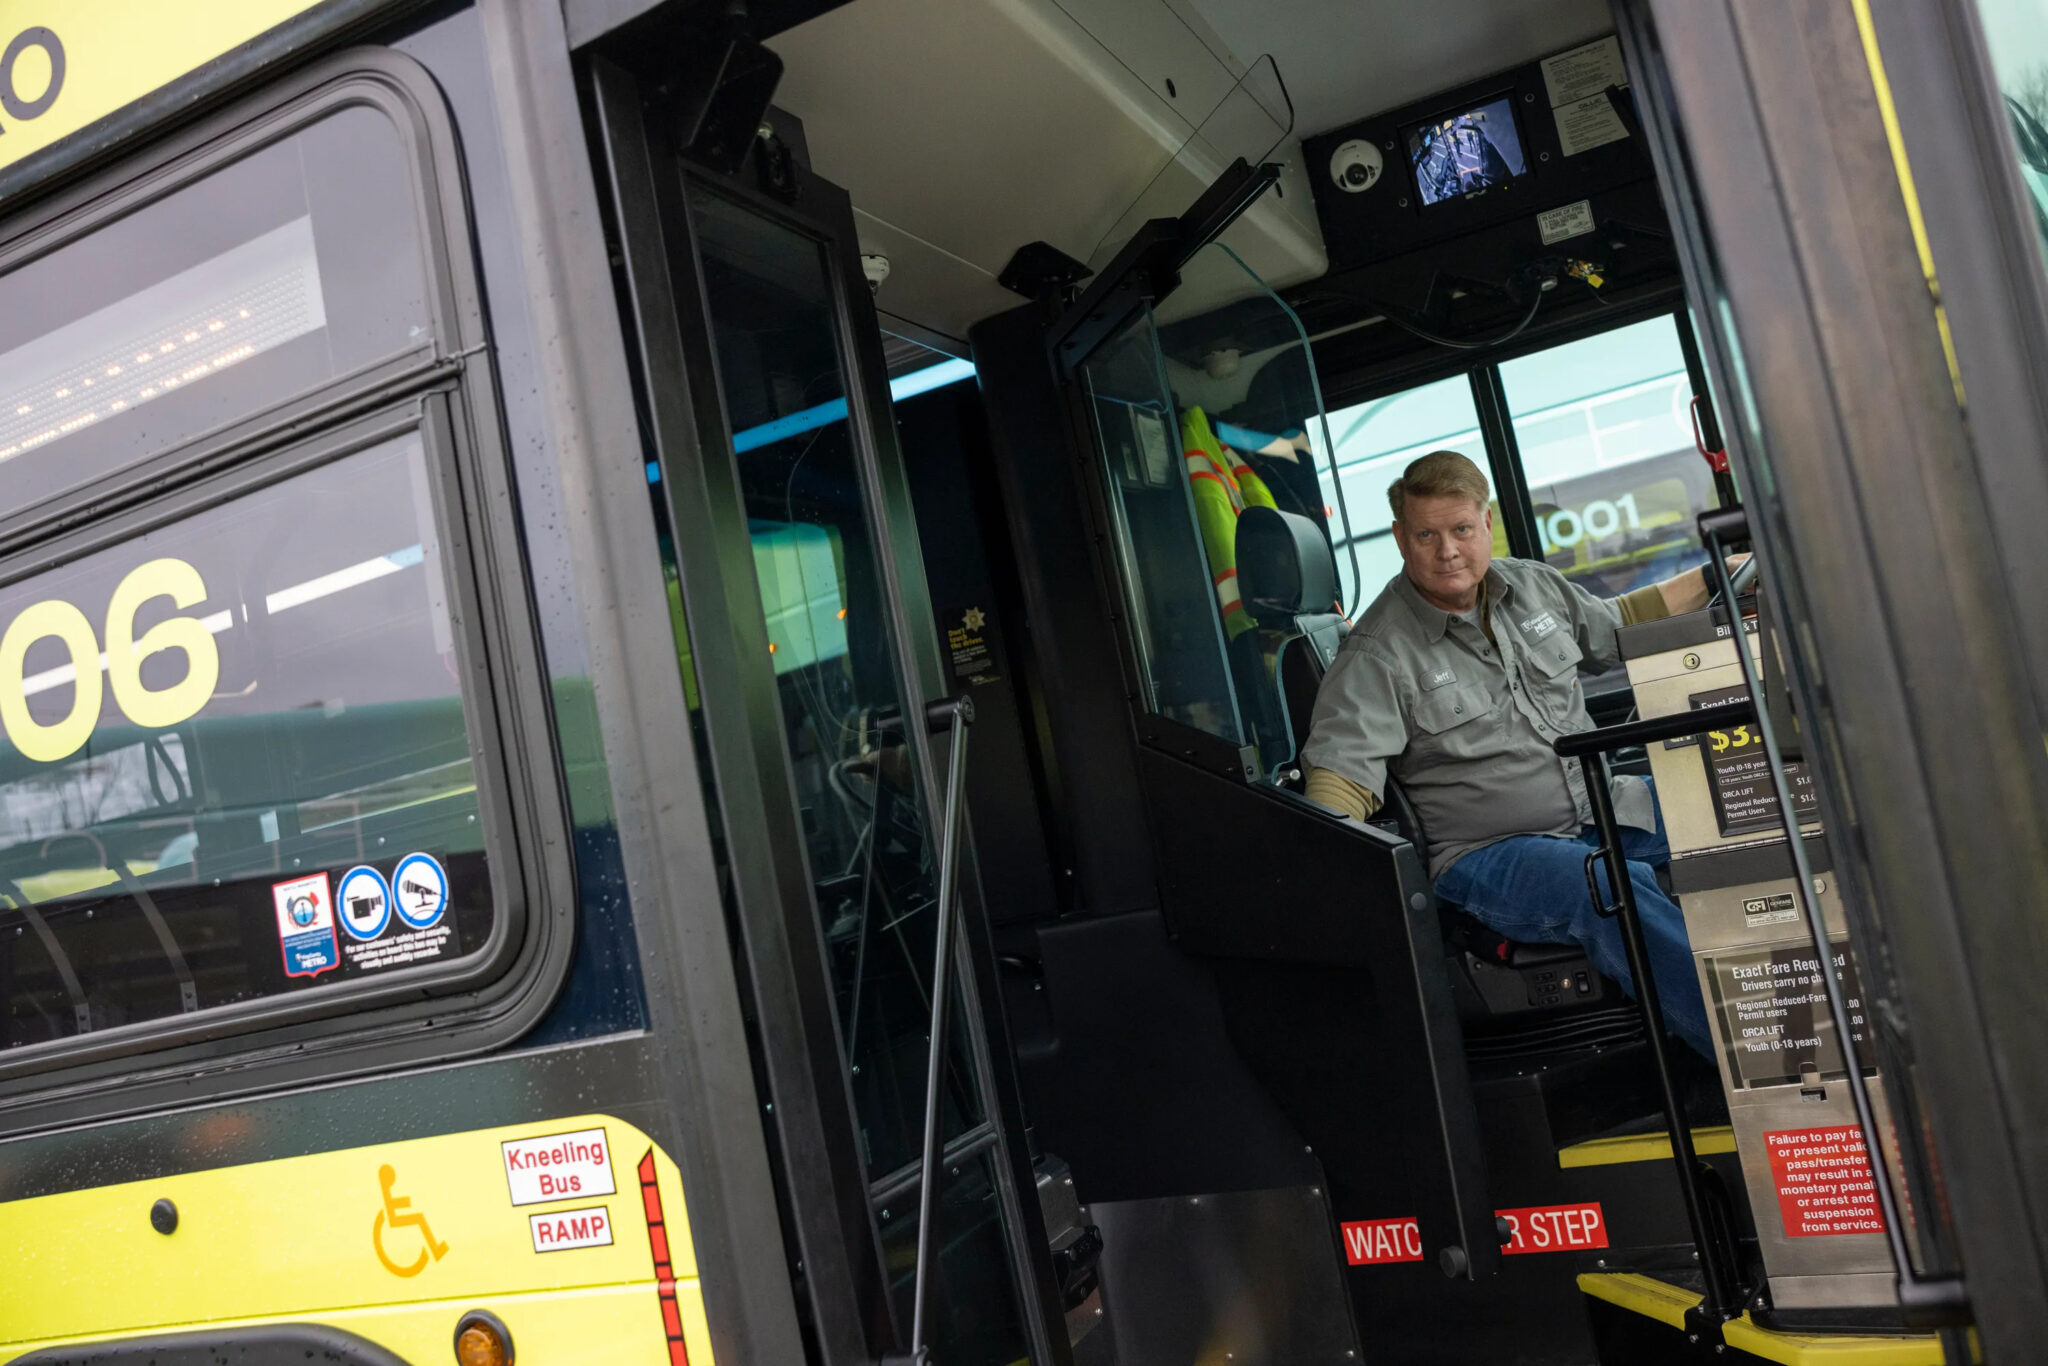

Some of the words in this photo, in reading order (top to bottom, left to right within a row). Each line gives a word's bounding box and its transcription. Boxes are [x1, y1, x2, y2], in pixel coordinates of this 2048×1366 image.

[1717, 626, 1731, 637] Bil
[0, 558, 219, 762] 06
[1434, 671, 1450, 684] Jeff
[1708, 725, 1762, 754] $3.
[1717, 764, 1735, 774] Youth
[1736, 762, 1752, 773] (0-18
[1753, 760, 1768, 771] year
[1722, 788, 1740, 799] ORCA
[1741, 786, 1754, 796] LIFT
[1725, 800, 1752, 811] Regional
[1727, 809, 1747, 819] Permit
[1748, 806, 1766, 816] Users
[1732, 964, 1762, 980] Exact
[1765, 962, 1791, 975] Fare
[1792, 953, 1846, 972] Requed
[1742, 978, 1773, 992] Drivers
[1774, 976, 1796, 989] carry
[1798, 975, 1809, 985] no
[1736, 999, 1770, 1012] Regional
[1772, 993, 1827, 1006] Reduced-Fare
[1738, 1010, 1765, 1021] Permit
[1766, 1007, 1788, 1018] users
[1742, 1026, 1766, 1038] ORCA
[1767, 1024, 1785, 1035] LIFT
[1850, 1015, 1863, 1025] .00
[1745, 1040, 1770, 1053] Youth
[1771, 1038, 1793, 1051] (0-18
[1794, 1036, 1822, 1049] years)
[1768, 1133, 1807, 1145] Failure
[1810, 1132, 1822, 1142] to
[1825, 1130, 1846, 1143] pay
[1849, 1129, 1863, 1139] fa
[508, 1141, 604, 1171] Kneeling
[1778, 1148, 1791, 1157] or
[1794, 1144, 1840, 1158] present
[1786, 1156, 1867, 1171] pass/transfer
[1787, 1171, 1811, 1183] may
[1814, 1169, 1849, 1181] result
[1851, 1167, 1862, 1177] in
[1866, 1169, 1873, 1177] a
[539, 1174, 582, 1195] Bus
[1781, 1183, 1837, 1196] monetary
[1840, 1180, 1876, 1194] penal
[1797, 1198, 1810, 1207] or
[1812, 1195, 1849, 1206] arrest
[1851, 1193, 1874, 1203] and
[1803, 1206, 1874, 1221] suspension
[538, 1216, 605, 1244] RAMP
[1802, 1222, 1831, 1232] from
[1833, 1219, 1882, 1231] service.
[1346, 1222, 1423, 1260] WATC
[1530, 1209, 1599, 1248] STEP
